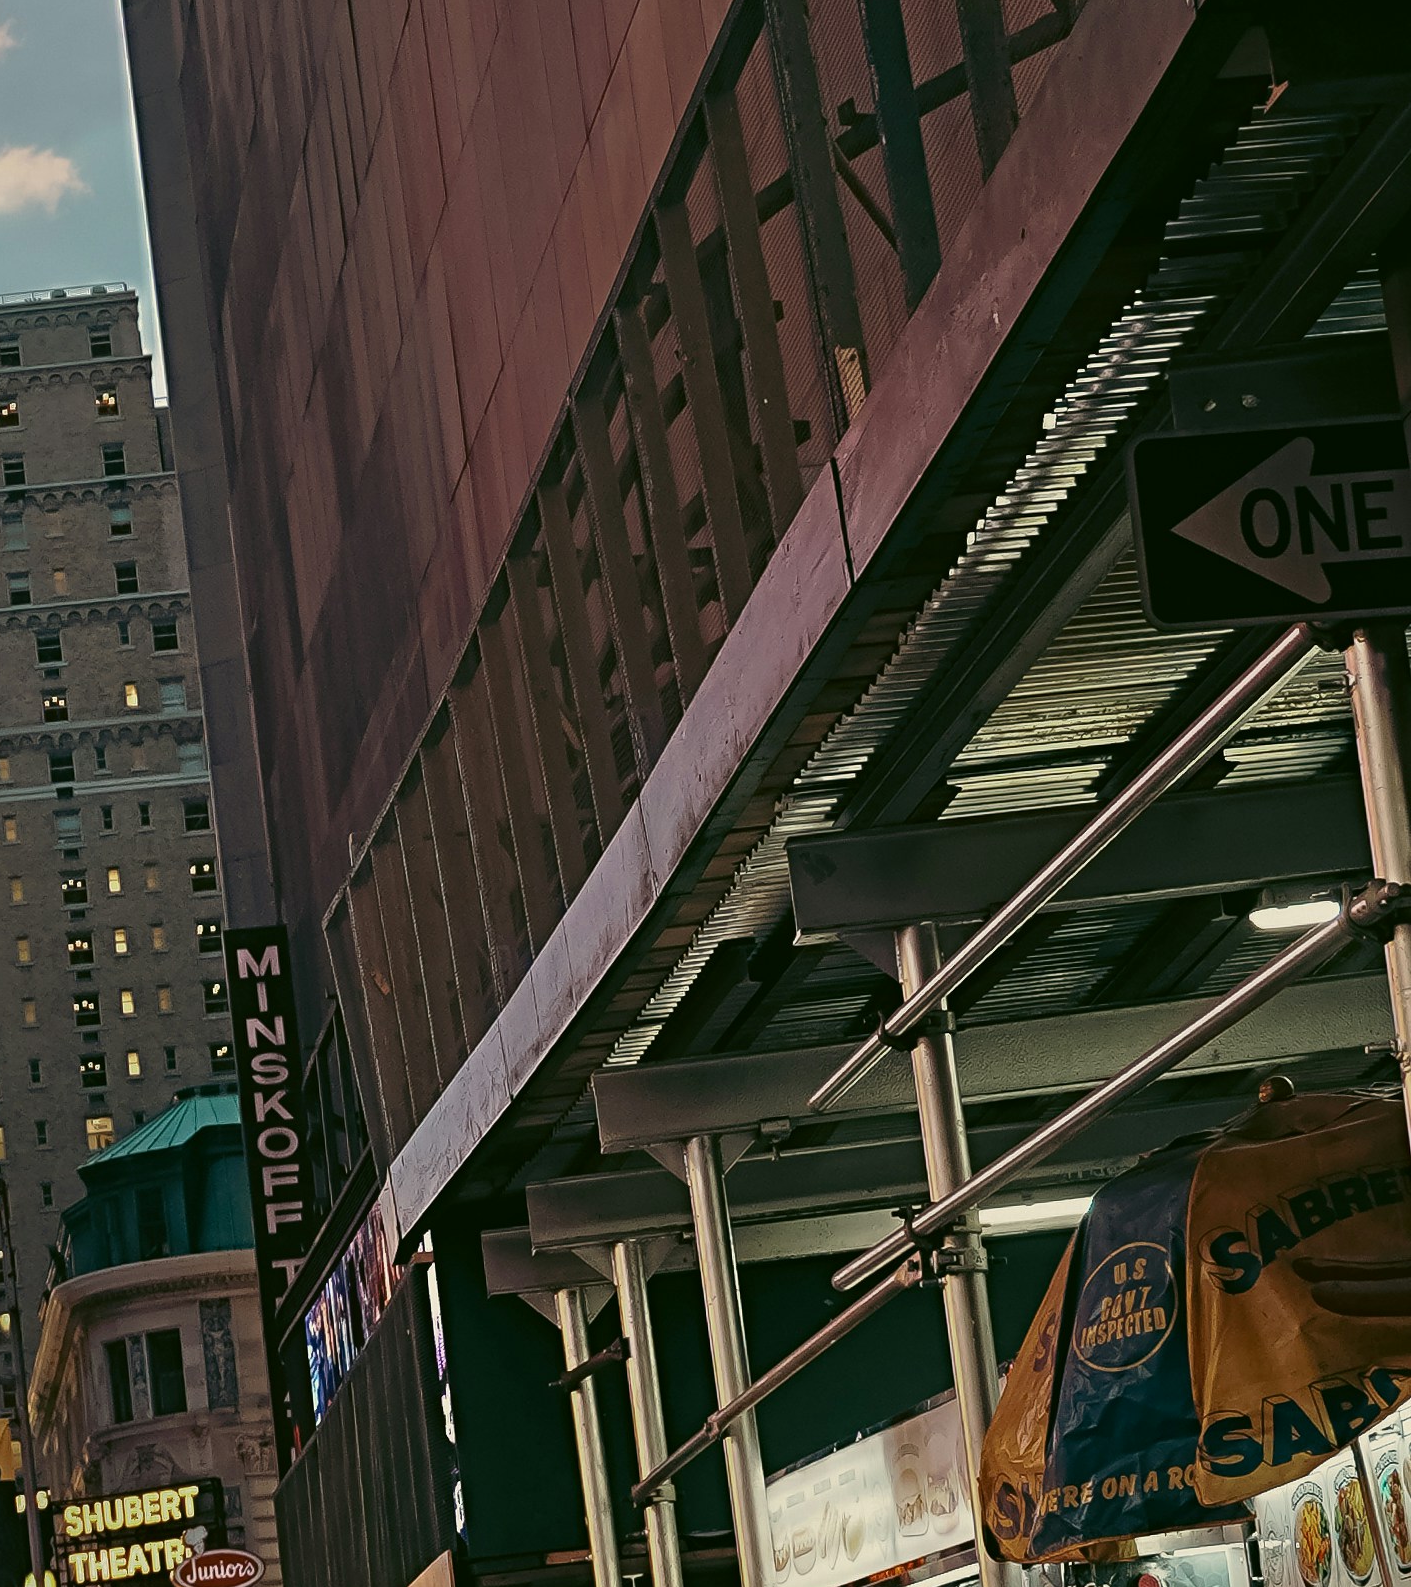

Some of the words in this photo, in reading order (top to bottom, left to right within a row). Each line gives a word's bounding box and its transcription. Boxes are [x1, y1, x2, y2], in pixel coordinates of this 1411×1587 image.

[1240, 479, 1402, 559] ONE
[236, 945, 303, 1234] MINSKOFF
[1201, 1165, 1411, 1294] SABRE
[1080, 1307, 1166, 1350] INSPECTED
[1103, 1472, 1136, 1499] ON
[1144, 1470, 1159, 1493] A
[64, 1486, 199, 1537] SHUBERT
[69, 1539, 191, 1583] THEATR
[186, 1556, 256, 1585] Junior's
